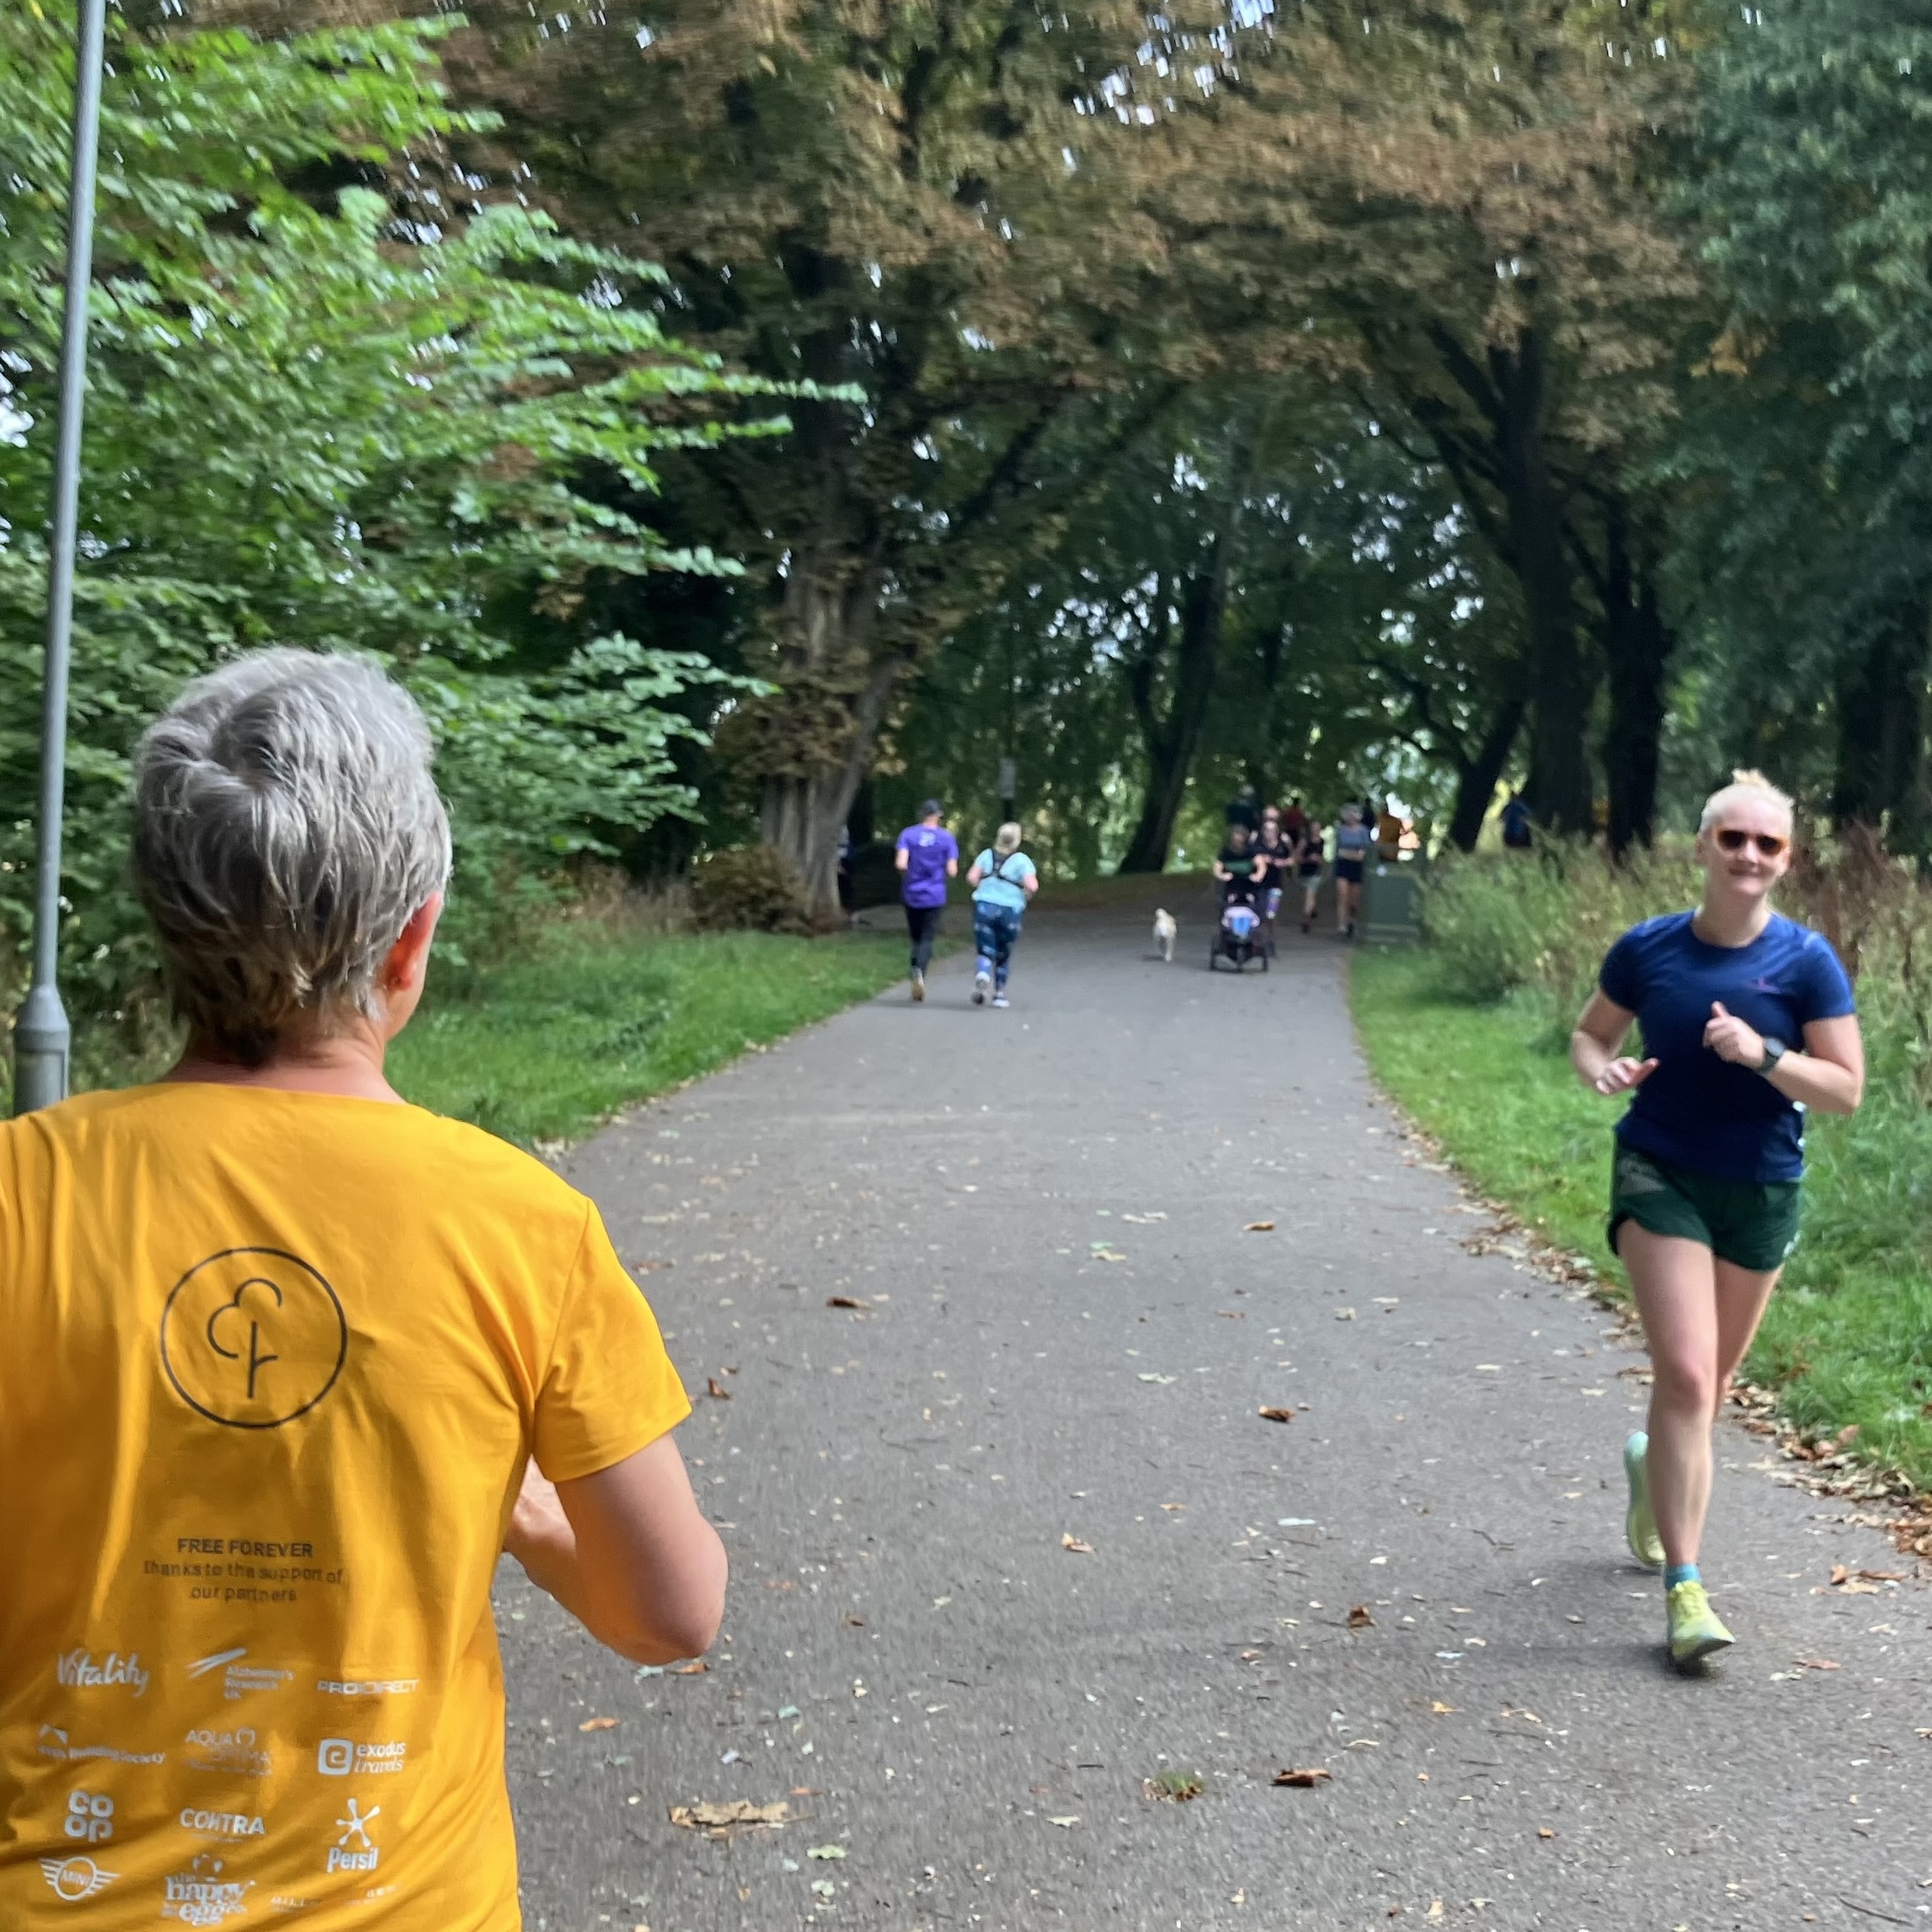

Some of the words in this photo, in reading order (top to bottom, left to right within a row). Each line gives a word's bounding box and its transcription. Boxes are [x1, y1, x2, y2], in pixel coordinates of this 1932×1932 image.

[178, 1538, 225, 1555] FREE
[229, 1540, 313, 1558] FOREVER
[143, 1560, 201, 1577] thanks
[206, 1562, 223, 1577] to
[227, 1562, 256, 1579] the
[260, 1565, 324, 1583] support
[326, 1568, 344, 1585] of
[191, 1586, 219, 1600] our
[57, 1647, 149, 1699] Vitality
[357, 1740, 406, 1758] exodus
[180, 1808, 265, 1835] CONTRA
[326, 1846, 379, 1873] Persil
